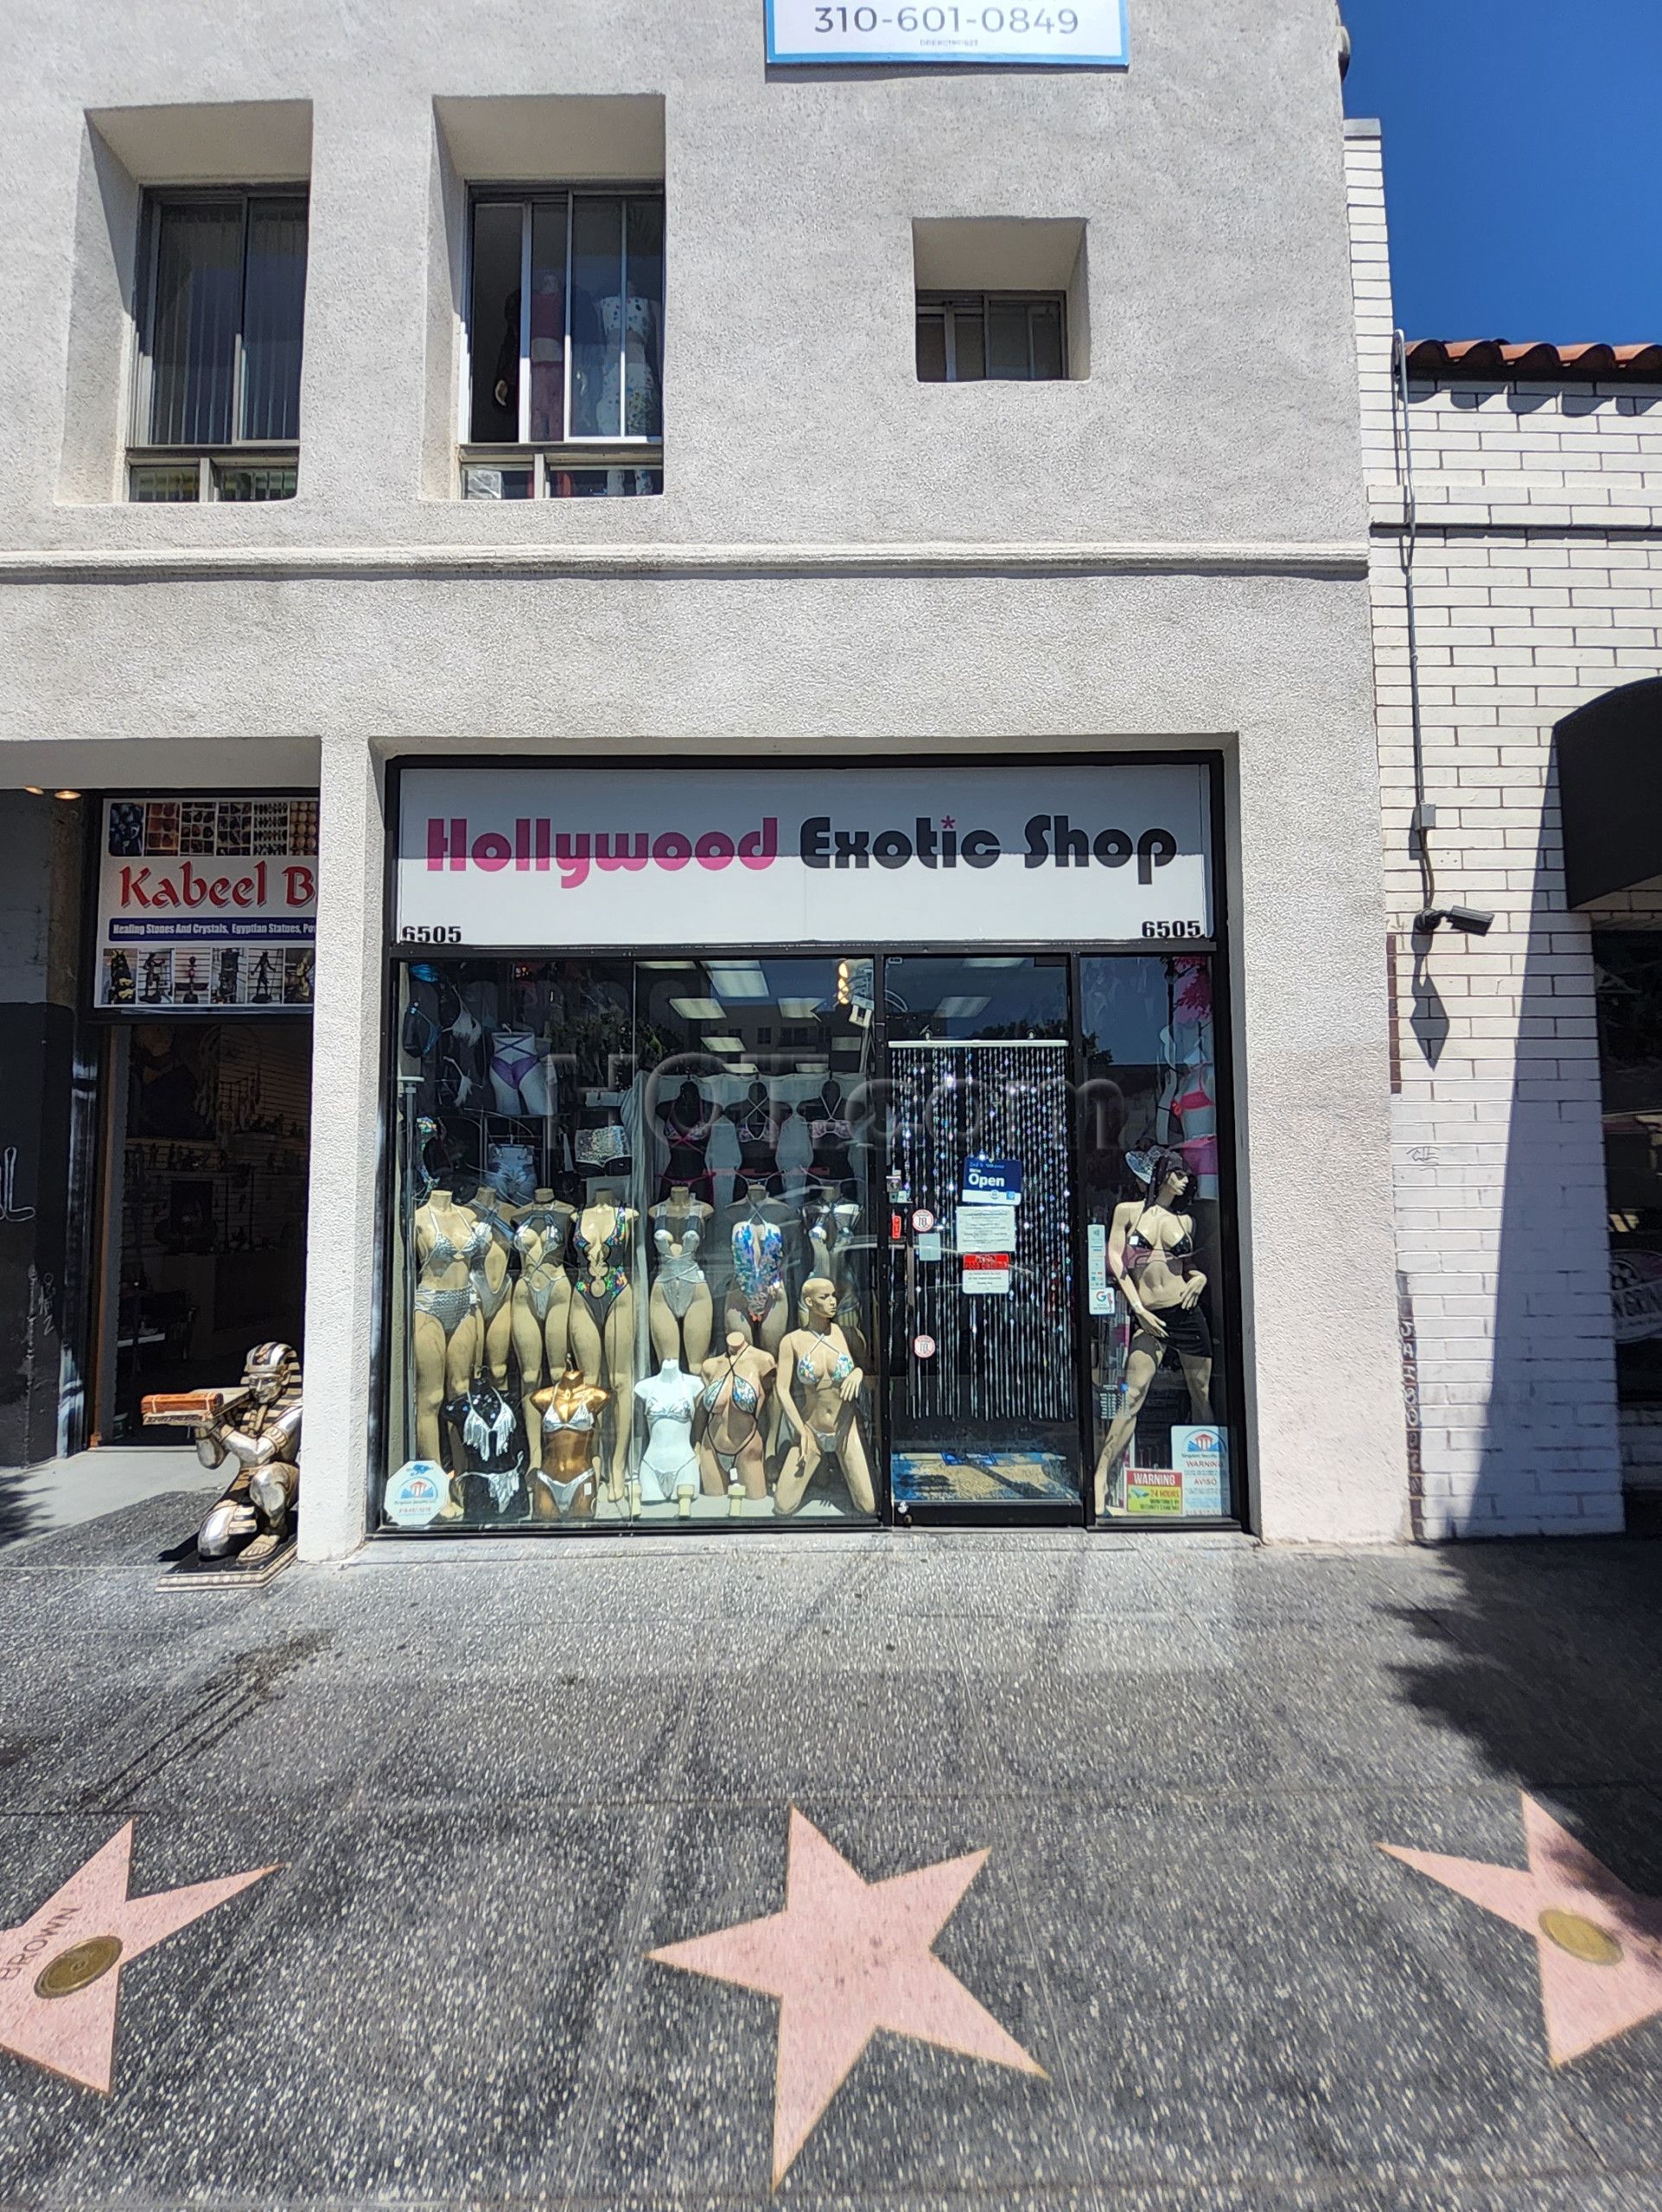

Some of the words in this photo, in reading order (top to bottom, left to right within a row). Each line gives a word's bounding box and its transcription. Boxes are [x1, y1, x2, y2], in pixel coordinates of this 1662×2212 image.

[814, 6, 1079, 34] 310-601-0849
[427, 817, 778, 888] Hollywood
[800, 816, 1001, 869] Exotic
[1024, 815, 1177, 885] Shop
[118, 860, 269, 907] Kabeel
[113, 924, 144, 935] Healing
[146, 924, 175, 935] Stones
[175, 924, 192, 934] And
[193, 924, 229, 935] Crystals,
[232, 924, 267, 935] Egyptian
[268, 924, 302, 935] Statues,
[402, 925, 462, 944] 6505
[1142, 920, 1200, 938] 6505
[968, 1173, 1005, 1188] Open
[1133, 1472, 1176, 1485] WARNING
[1, 1905, 83, 1982] BROWN
